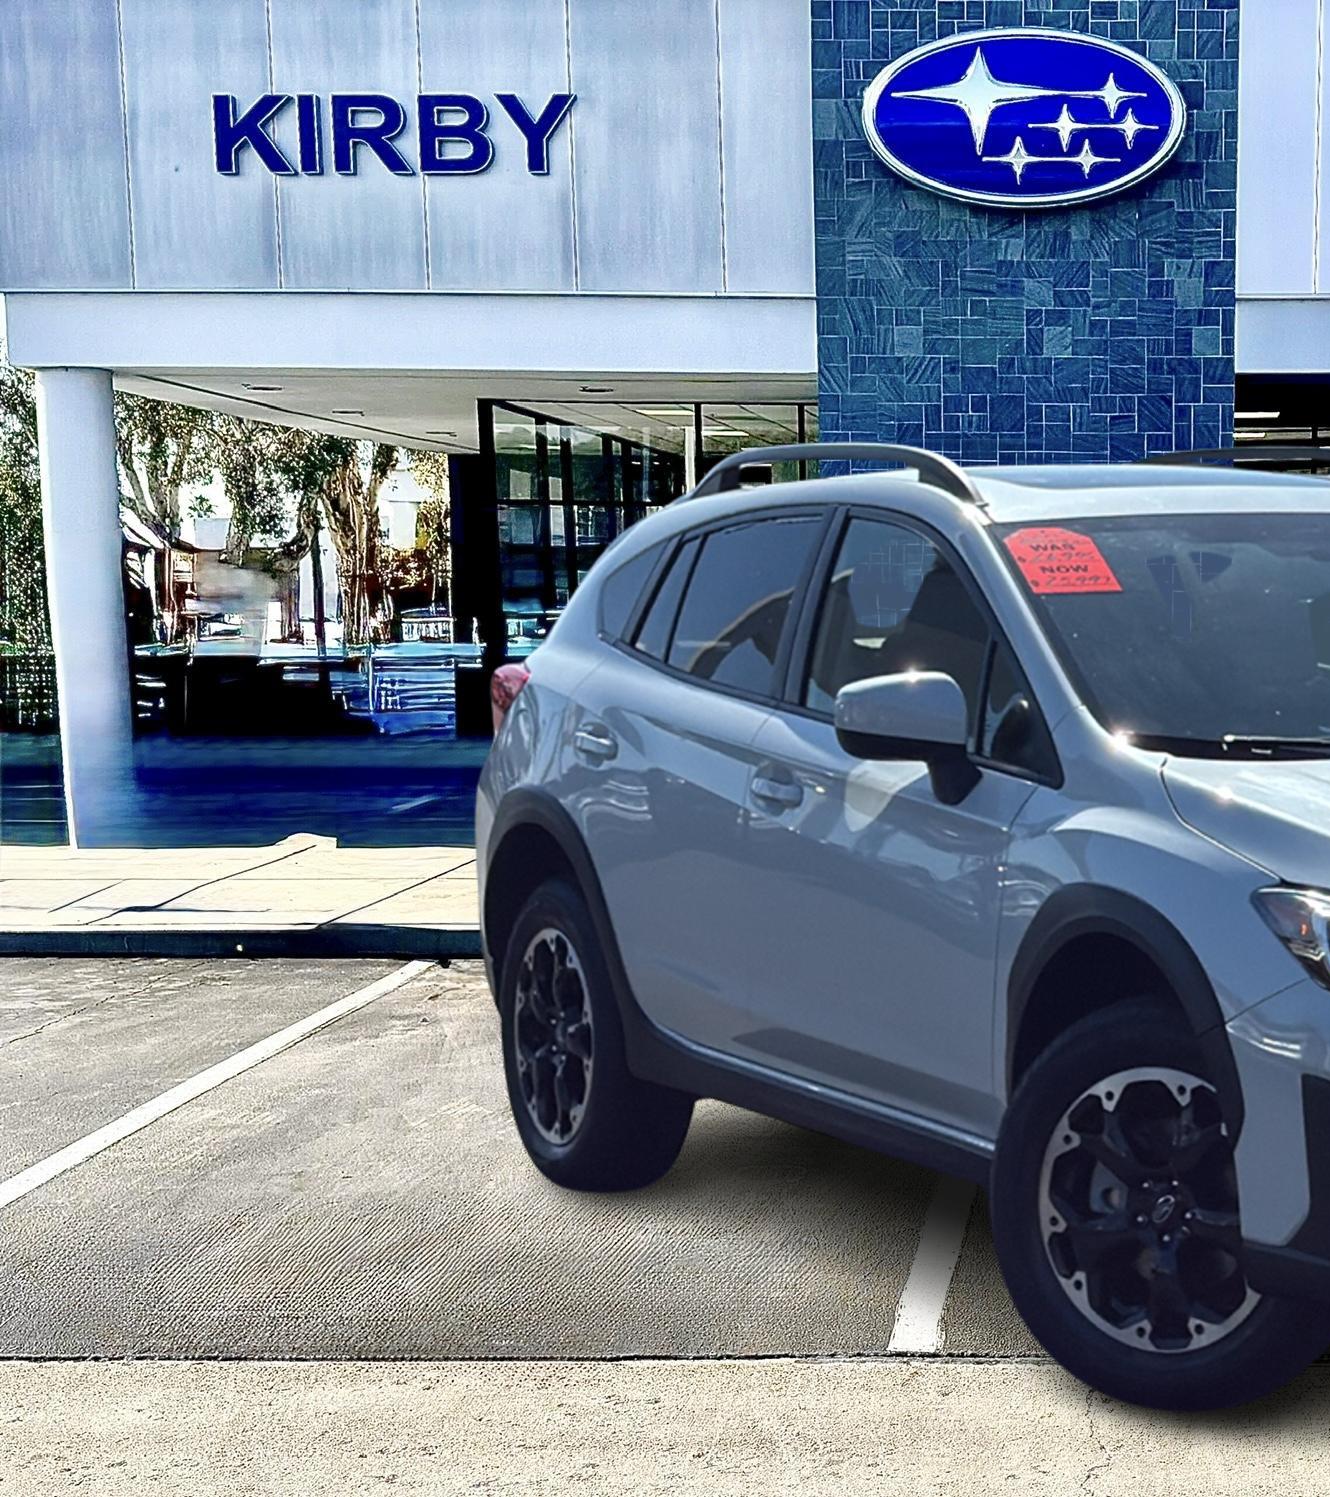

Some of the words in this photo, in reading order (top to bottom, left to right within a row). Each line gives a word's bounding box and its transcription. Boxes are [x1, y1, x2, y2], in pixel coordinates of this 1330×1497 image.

[212, 94, 577, 176] KIRBY
[1030, 543, 1076, 551] WAS
[1040, 564, 1088, 574] NOW
